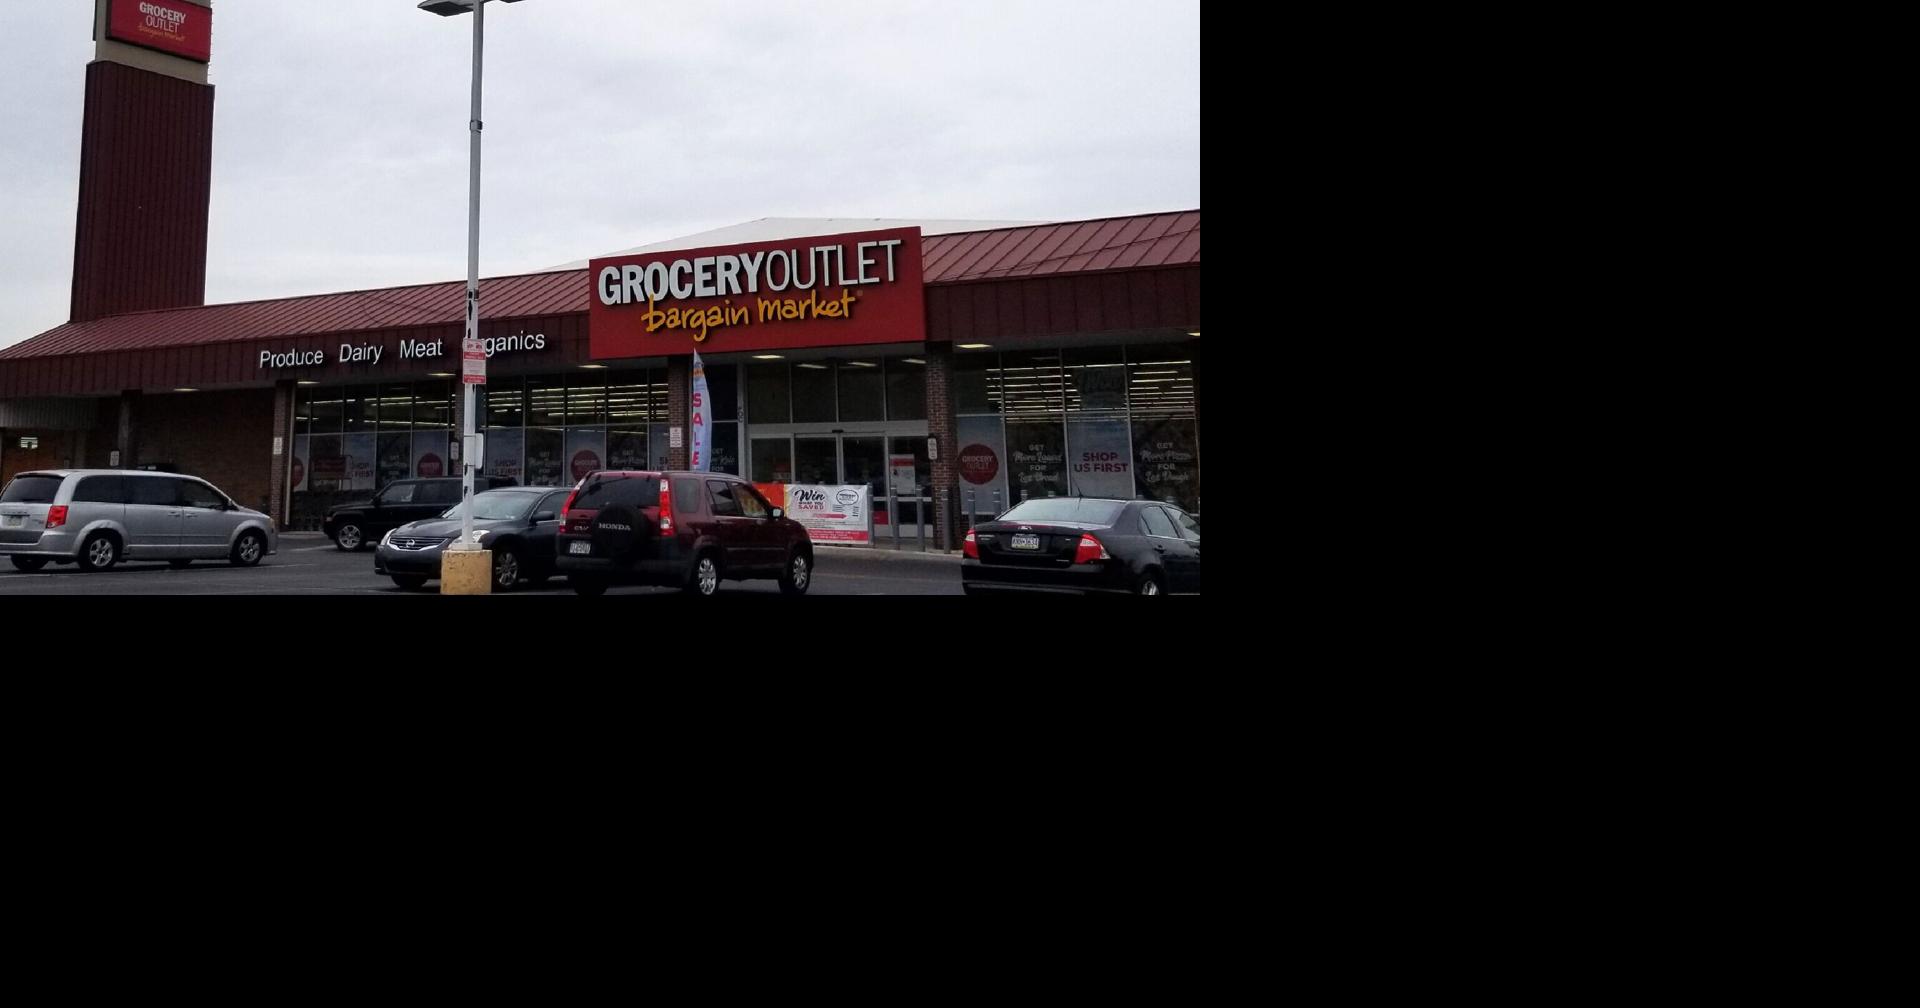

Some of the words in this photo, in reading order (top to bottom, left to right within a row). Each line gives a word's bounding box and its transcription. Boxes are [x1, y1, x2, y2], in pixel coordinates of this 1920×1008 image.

[139, 2, 187, 23] GROCERY
[145, 15, 179, 33] OUTLET
[641, 293, 749, 341] bargain
[758, 288, 856, 322] market
[259, 349, 324, 368] Produce
[339, 343, 383, 365] Dairy
[400, 338, 443, 359] Meat
[480, 330, 545, 358] ganics
[692, 392, 703, 465] SALE
[962, 455, 994, 464] GROCERY
[1082, 452, 1119, 462] SHOP
[1074, 463, 1091, 473] US
[1094, 463, 1128, 473] FIRST
[794, 489, 826, 501] Win
[598, 522, 631, 531] HONDA
